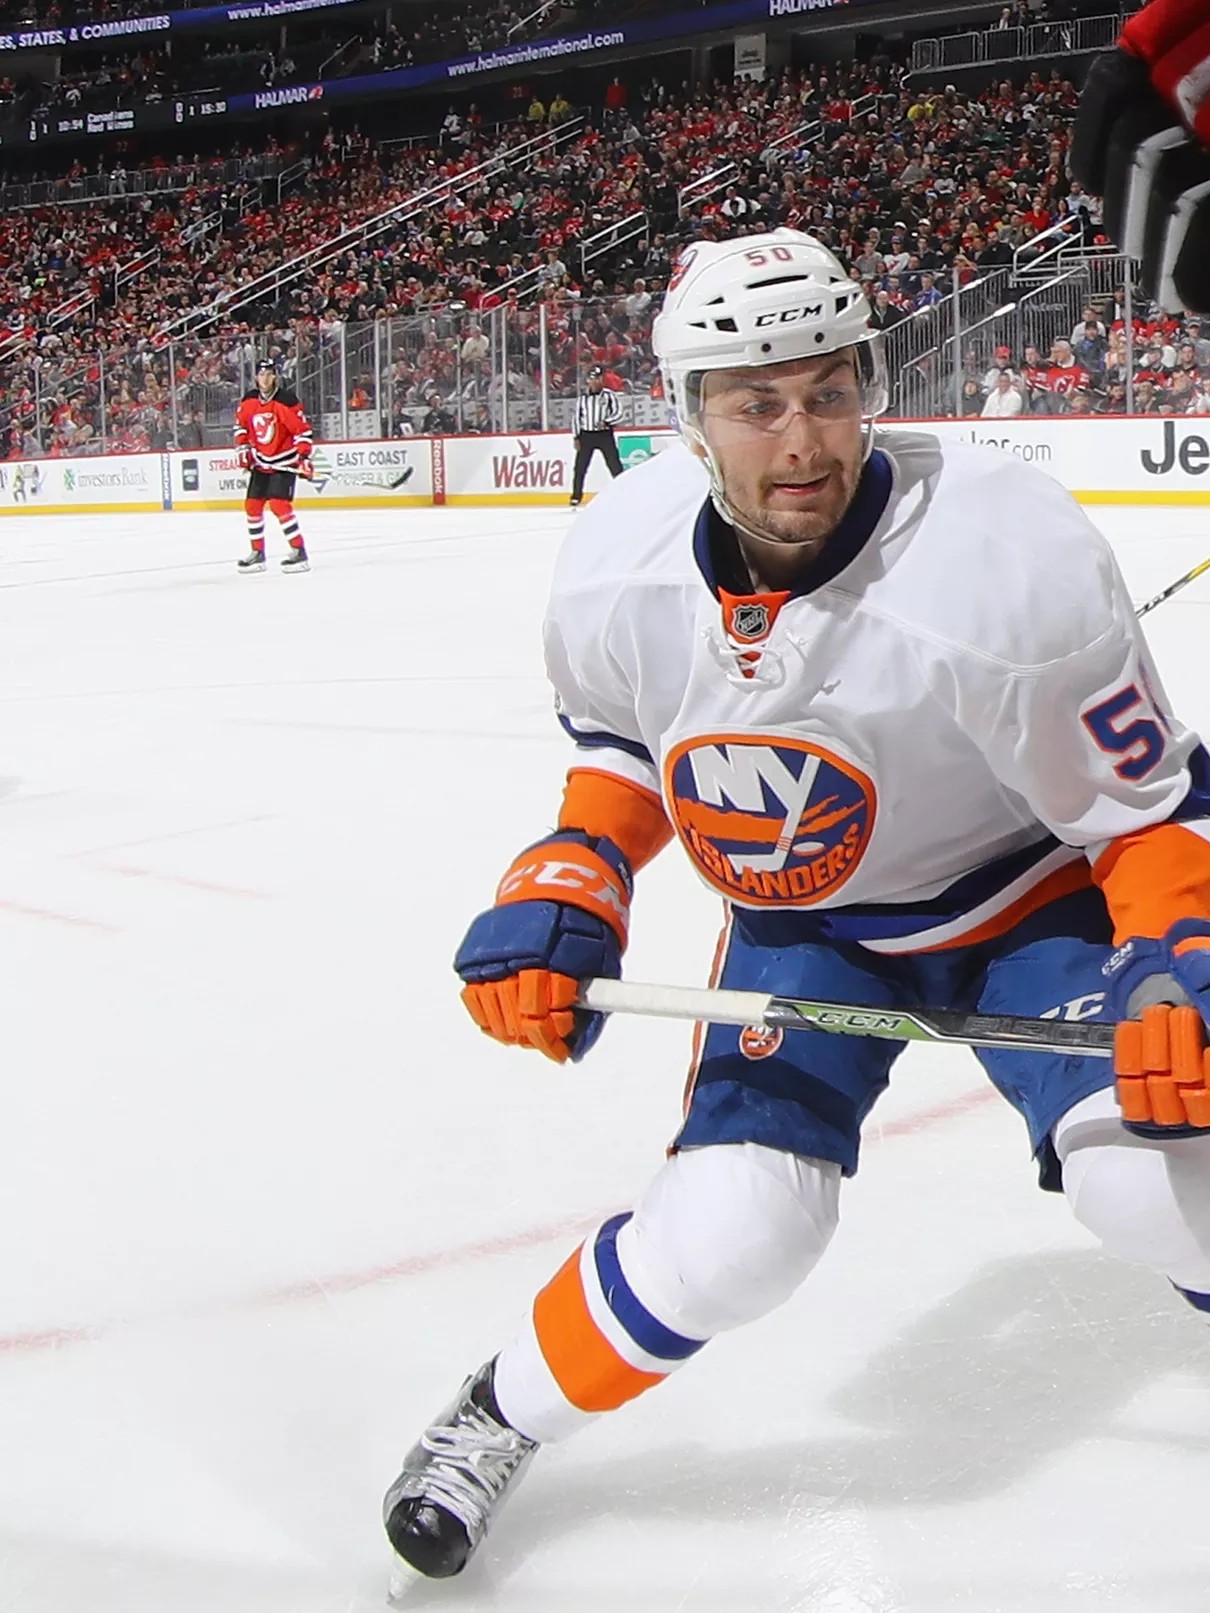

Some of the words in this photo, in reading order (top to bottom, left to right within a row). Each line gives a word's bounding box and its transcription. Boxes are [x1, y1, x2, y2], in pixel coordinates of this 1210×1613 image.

[19, 30, 67, 48] STATES,
[69, 28, 79, 41] &
[81, 15, 171, 40] COMMUNITIES
[255, 87, 308, 109] HALMAR
[745, 247, 794, 267] 50
[754, 303, 824, 328] CCM
[336, 451, 366, 467] EAST
[368, 449, 408, 466] COAST
[492, 455, 565, 489] Wawa
[1080, 660, 1174, 782] 5
[687, 743, 822, 872] NY
[690, 822, 861, 898] ISLANDERS
[816, 1010, 902, 1032] CCM
